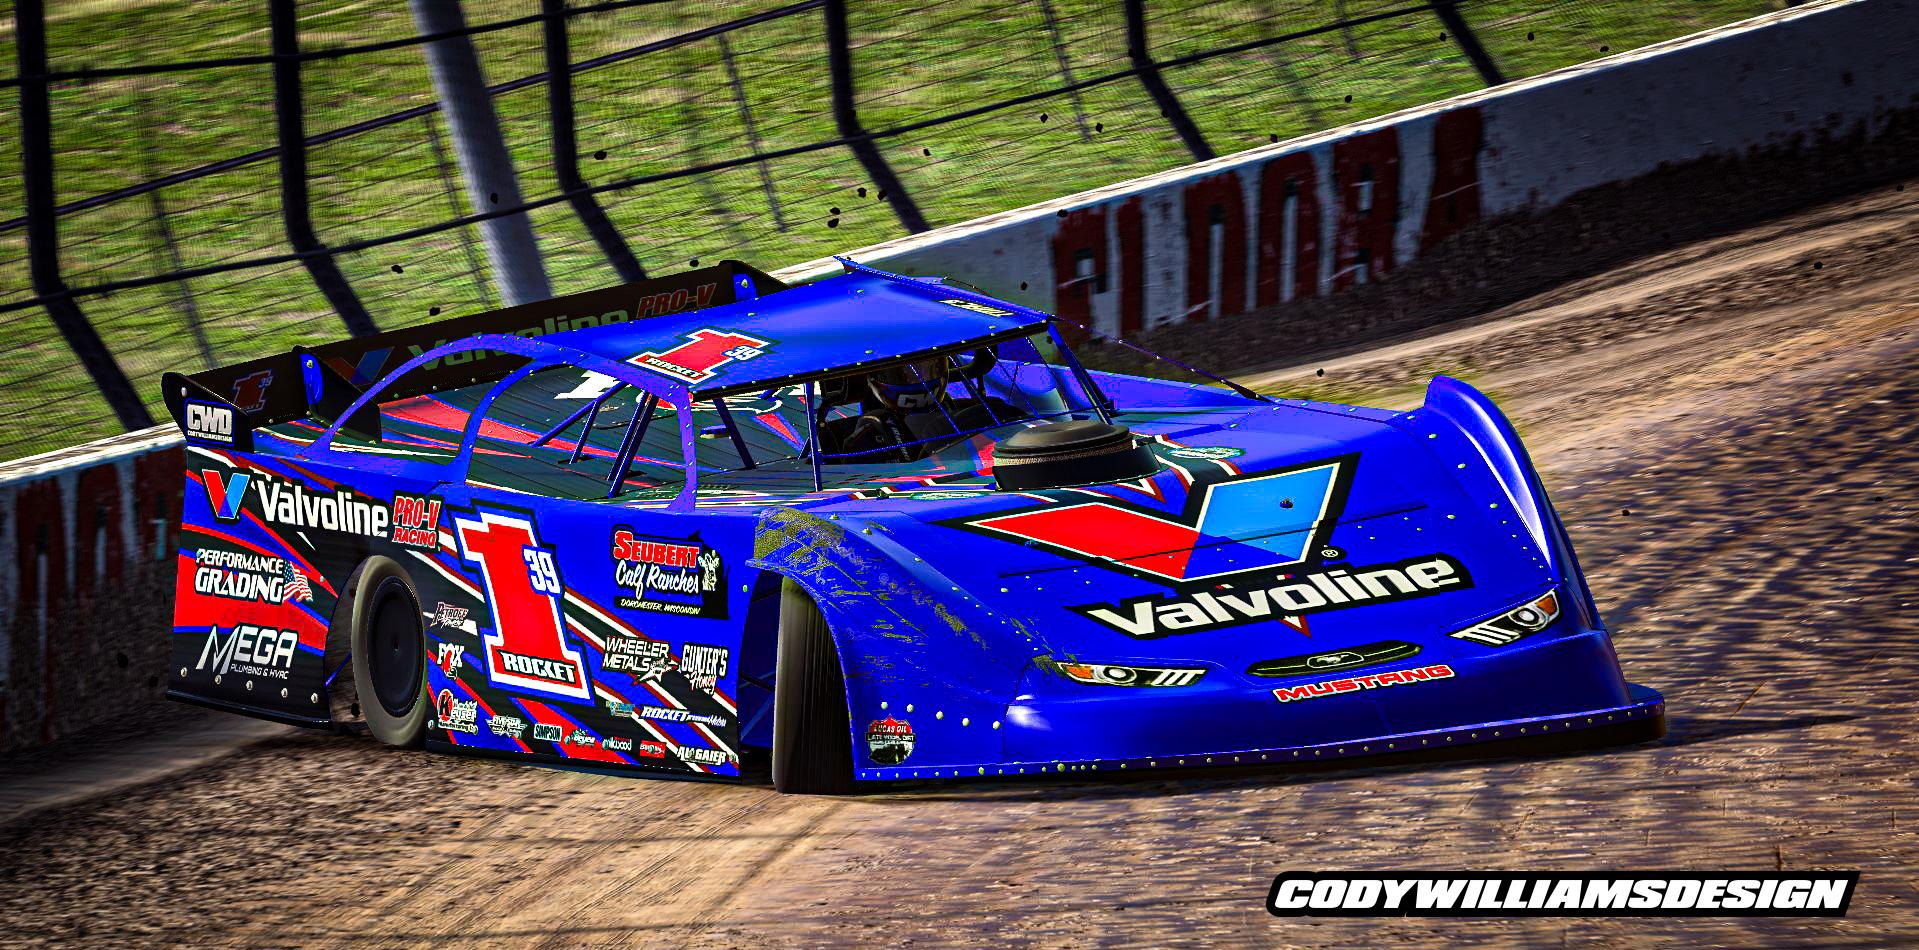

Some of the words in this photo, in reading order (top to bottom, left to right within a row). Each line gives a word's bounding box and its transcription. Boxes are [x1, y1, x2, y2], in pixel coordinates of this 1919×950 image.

[187, 403, 233, 435] CWD
[257, 479, 389, 538] Valvoline
[393, 495, 441, 531] PRO-V
[392, 526, 437, 549] RACING
[613, 530, 700, 569] SEUBERT
[196, 548, 284, 574] PERFORMANCE
[523, 548, 561, 594] 39
[195, 567, 285, 603] GRADING
[616, 559, 647, 600] Calf
[646, 564, 699, 594] Ranches
[1086, 557, 1461, 637] Valvoline
[195, 624, 298, 675] MEGA
[437, 642, 465, 668] FOX
[602, 652, 651, 672] METALS
[606, 636, 669, 658] WHEELER
[230, 663, 262, 676] PLUMBING
[269, 668, 290, 680] HVAC
[502, 651, 576, 683] ROCKET
[1273, 664, 1455, 703] MUSTANG
[641, 706, 690, 721] ROCKET
[535, 724, 561, 740] SIMPSON
